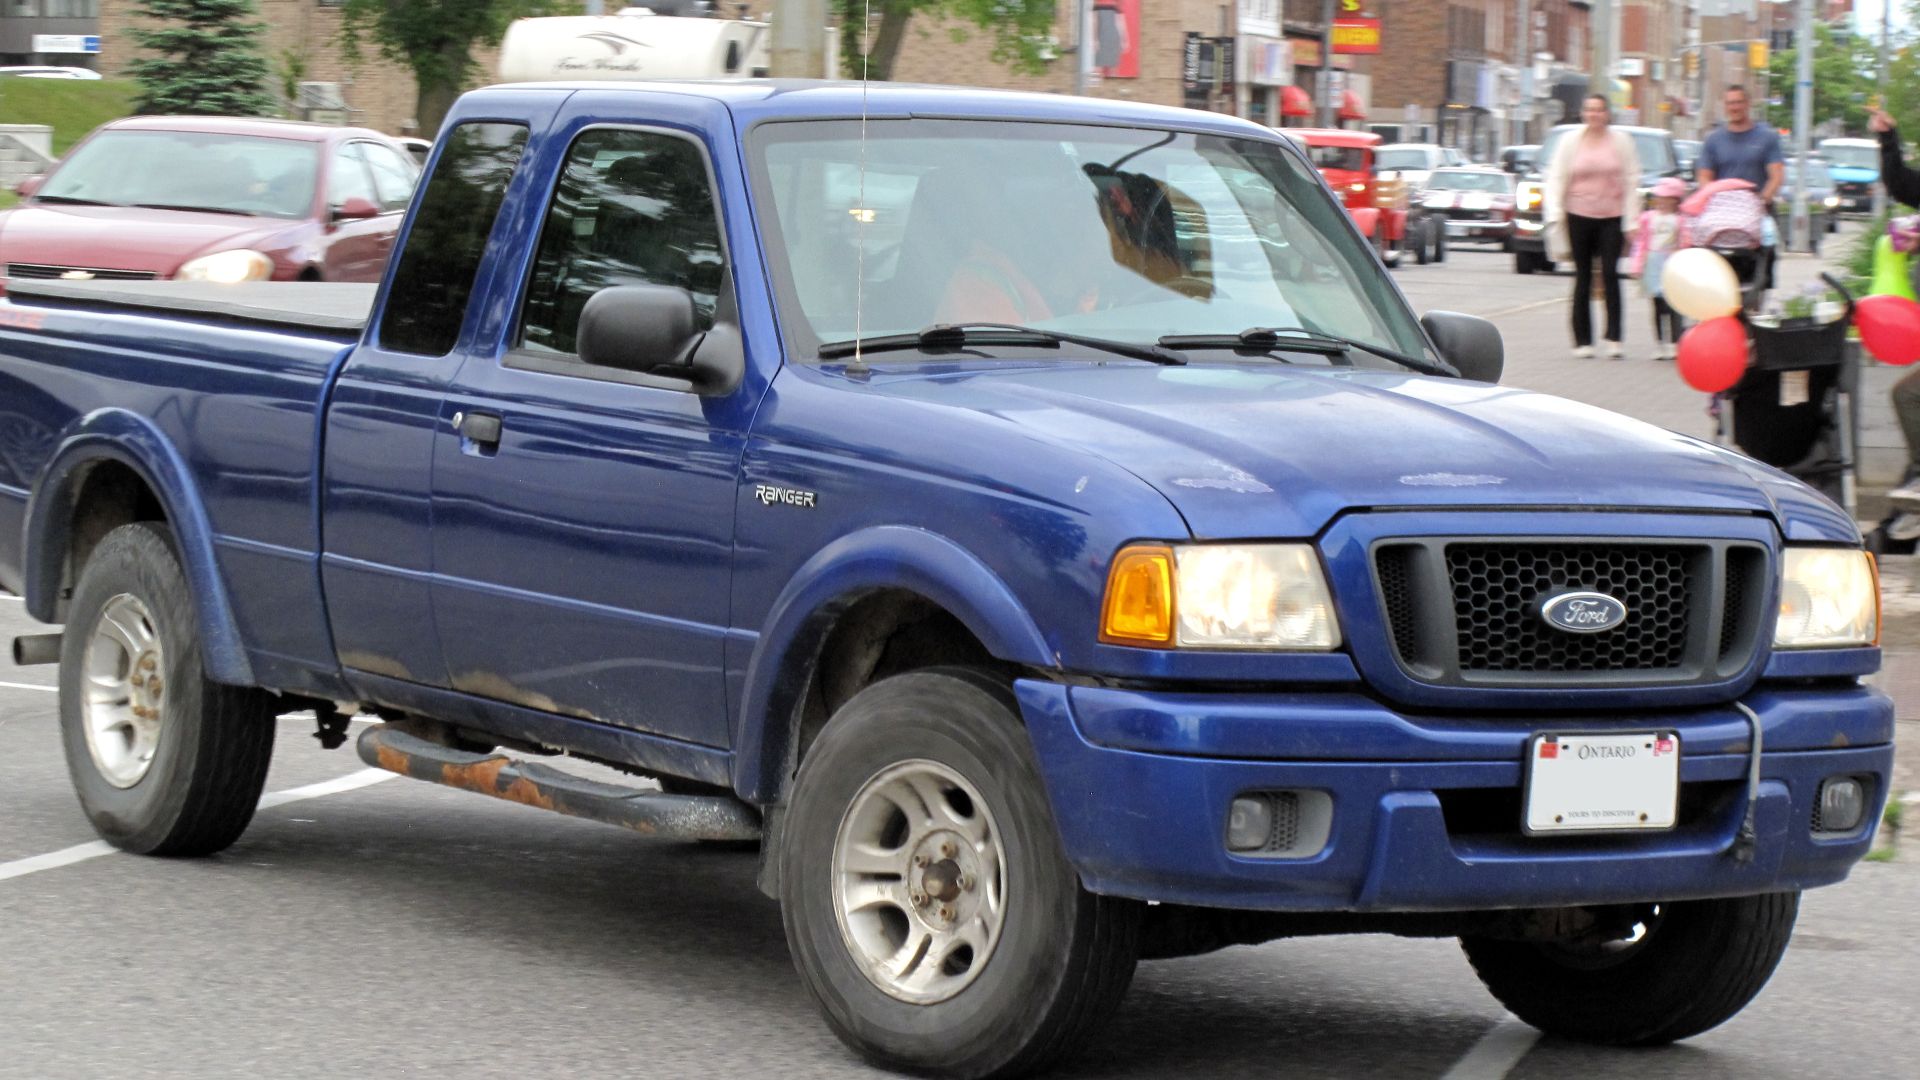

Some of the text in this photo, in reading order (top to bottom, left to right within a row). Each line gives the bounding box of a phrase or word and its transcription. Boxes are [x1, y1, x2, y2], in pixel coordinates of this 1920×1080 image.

[755, 484, 815, 507] RANGER
[1564, 600, 1609, 623] Ford
[1578, 744, 1635, 759] ONTARIO
